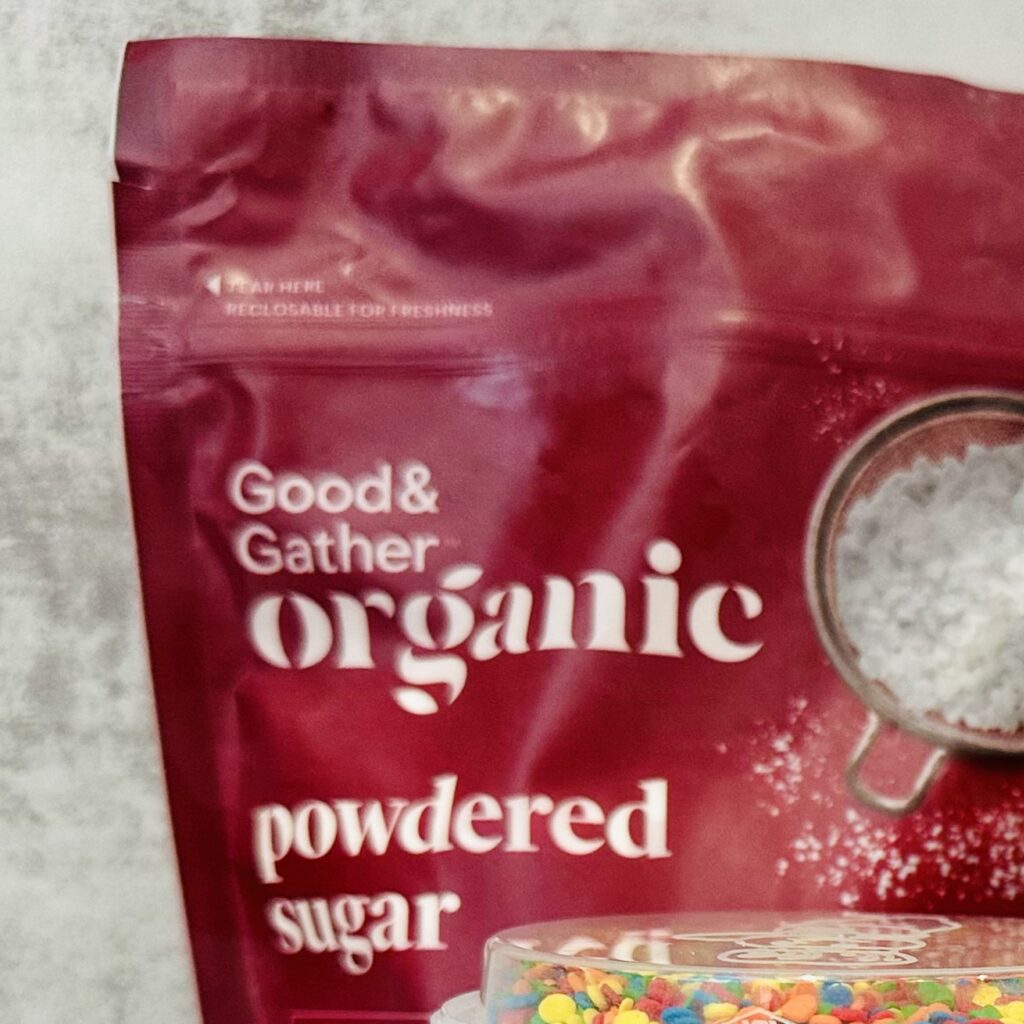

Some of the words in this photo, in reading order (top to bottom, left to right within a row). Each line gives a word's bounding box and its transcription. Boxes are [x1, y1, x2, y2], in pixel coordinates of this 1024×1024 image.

[225, 302, 344, 318] RECLOSABLE
[349, 302, 386, 318] FOR
[390, 302, 494, 318] FRESHNESS
[278, 279, 326, 294] HERE
[234, 522, 440, 575] Gather
[247, 539, 765, 716] organic
[252, 774, 674, 885] powdered
[267, 890, 461, 976] sugar
